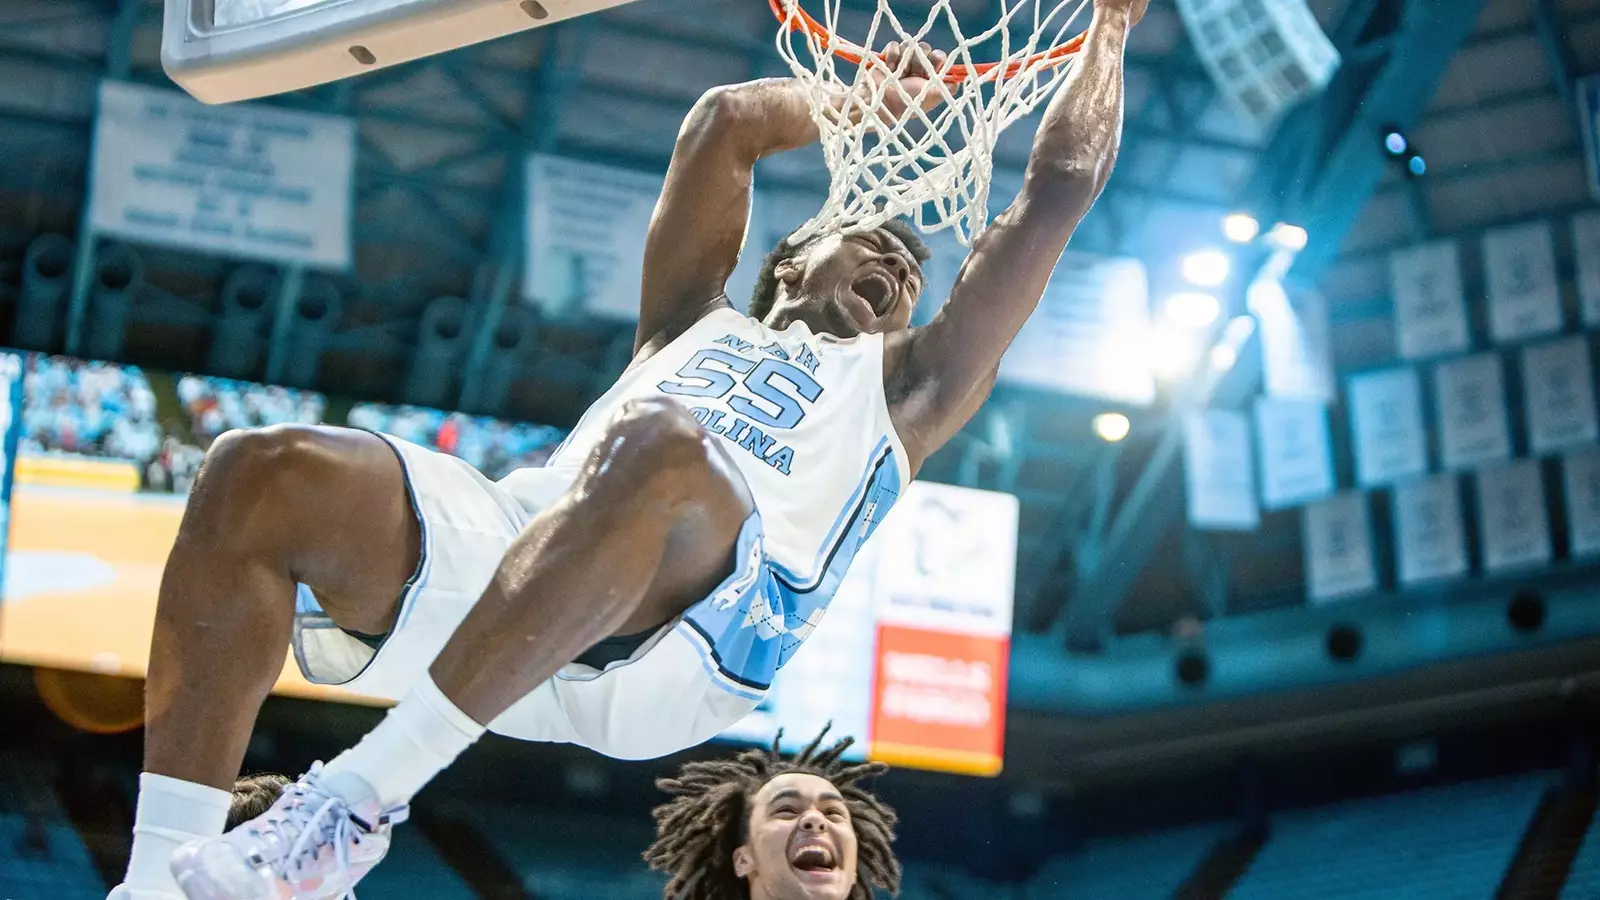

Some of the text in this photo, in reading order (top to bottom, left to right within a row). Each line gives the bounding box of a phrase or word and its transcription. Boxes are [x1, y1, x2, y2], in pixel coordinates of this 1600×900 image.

[656, 348, 825, 430] 55
[712, 333, 821, 377] NRH
[688, 406, 795, 477] OLINA
